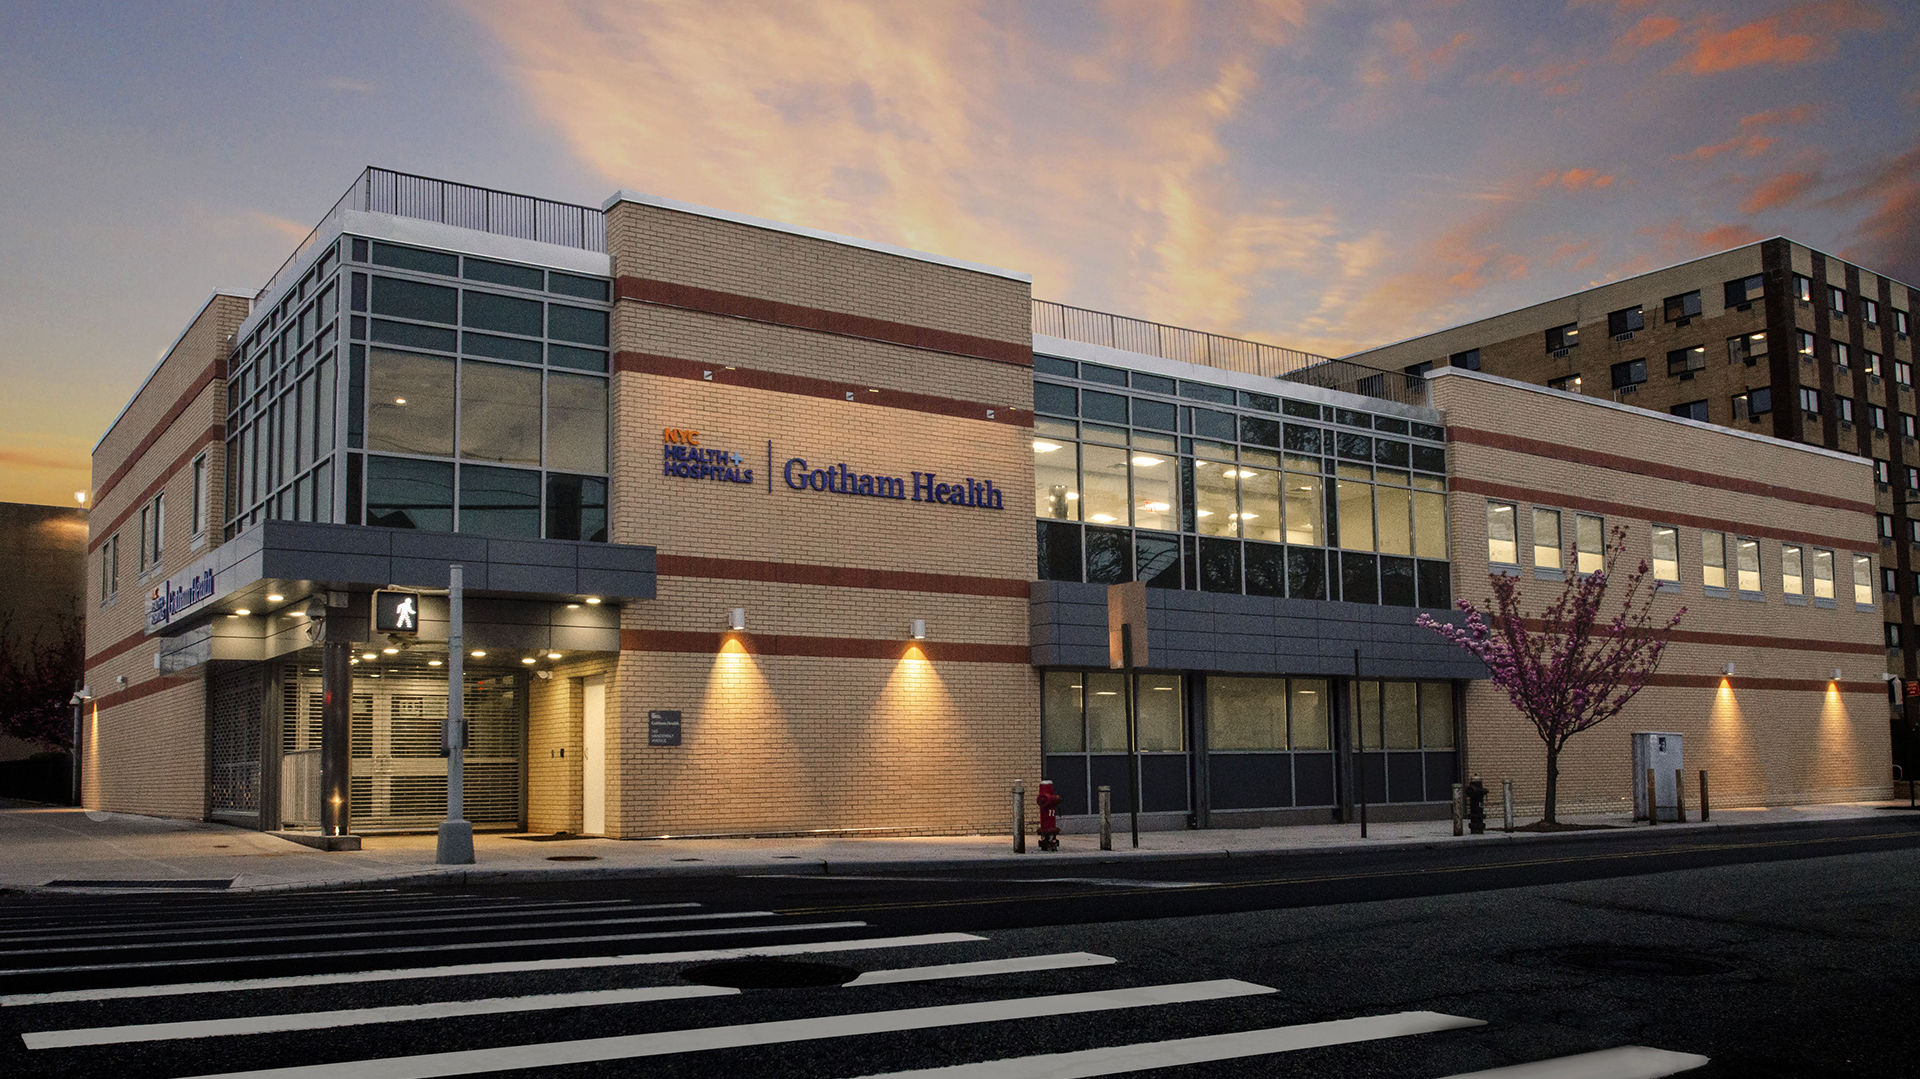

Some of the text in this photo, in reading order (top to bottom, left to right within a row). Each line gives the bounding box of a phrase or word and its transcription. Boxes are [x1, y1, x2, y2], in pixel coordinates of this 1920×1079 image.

[664, 428, 700, 445] NYC
[664, 461, 754, 484] HOSPITALS
[784, 458, 1004, 510] Gotham Health
